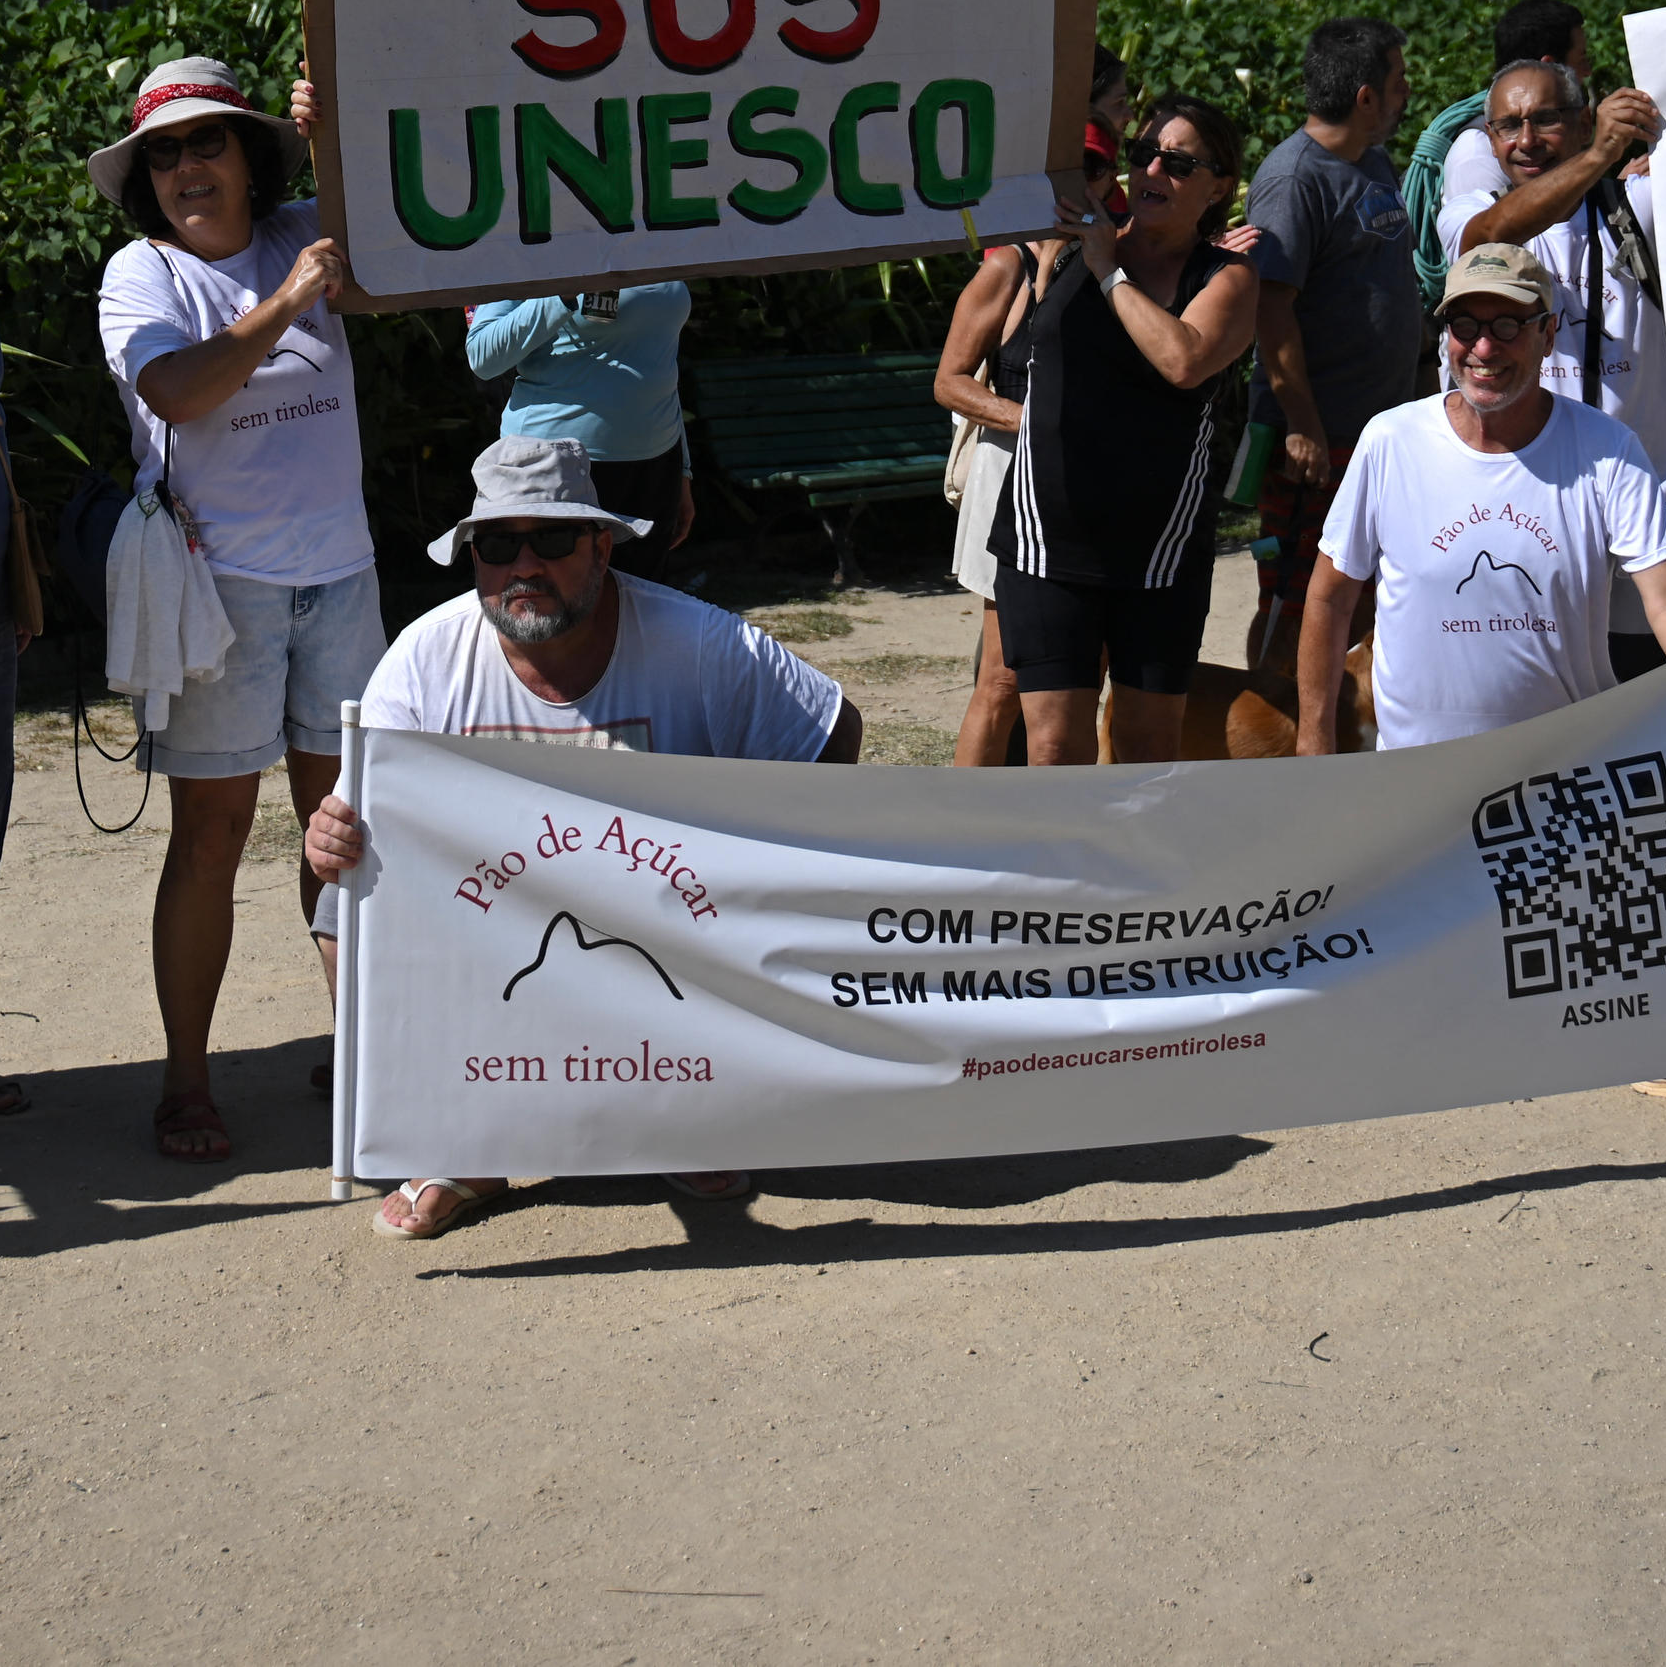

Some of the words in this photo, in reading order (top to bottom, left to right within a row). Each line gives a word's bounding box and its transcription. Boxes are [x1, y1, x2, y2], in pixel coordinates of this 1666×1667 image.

[389, 78, 996, 252] UNESCO
[1573, 358, 1632, 378] tilesa
[231, 410, 270, 432] sem
[275, 394, 341, 423] tirolesa
[1430, 521, 1465, 553] Pão
[1468, 503, 1492, 525] de
[1498, 503, 1559, 554] Açúcar
[1441, 619, 1481, 633] sem
[1489, 612, 1557, 633] tirolesa
[454, 848, 527, 914] Pão
[535, 813, 583, 861] de
[593, 815, 719, 924] Açúcar
[866, 906, 976, 946] COM
[990, 883, 1335, 946] PRESERVAÇÃO!
[831, 970, 929, 1009] SEM
[942, 966, 1052, 1002] MAIS
[1067, 927, 1376, 998] DESTRUIÇÃO!
[1560, 992, 1651, 1030] ASSINE
[463, 1050, 549, 1083] sem
[563, 1039, 715, 1083] tirolesa
[961, 1030, 1267, 1082] #paodeacucarsemtirolesa
